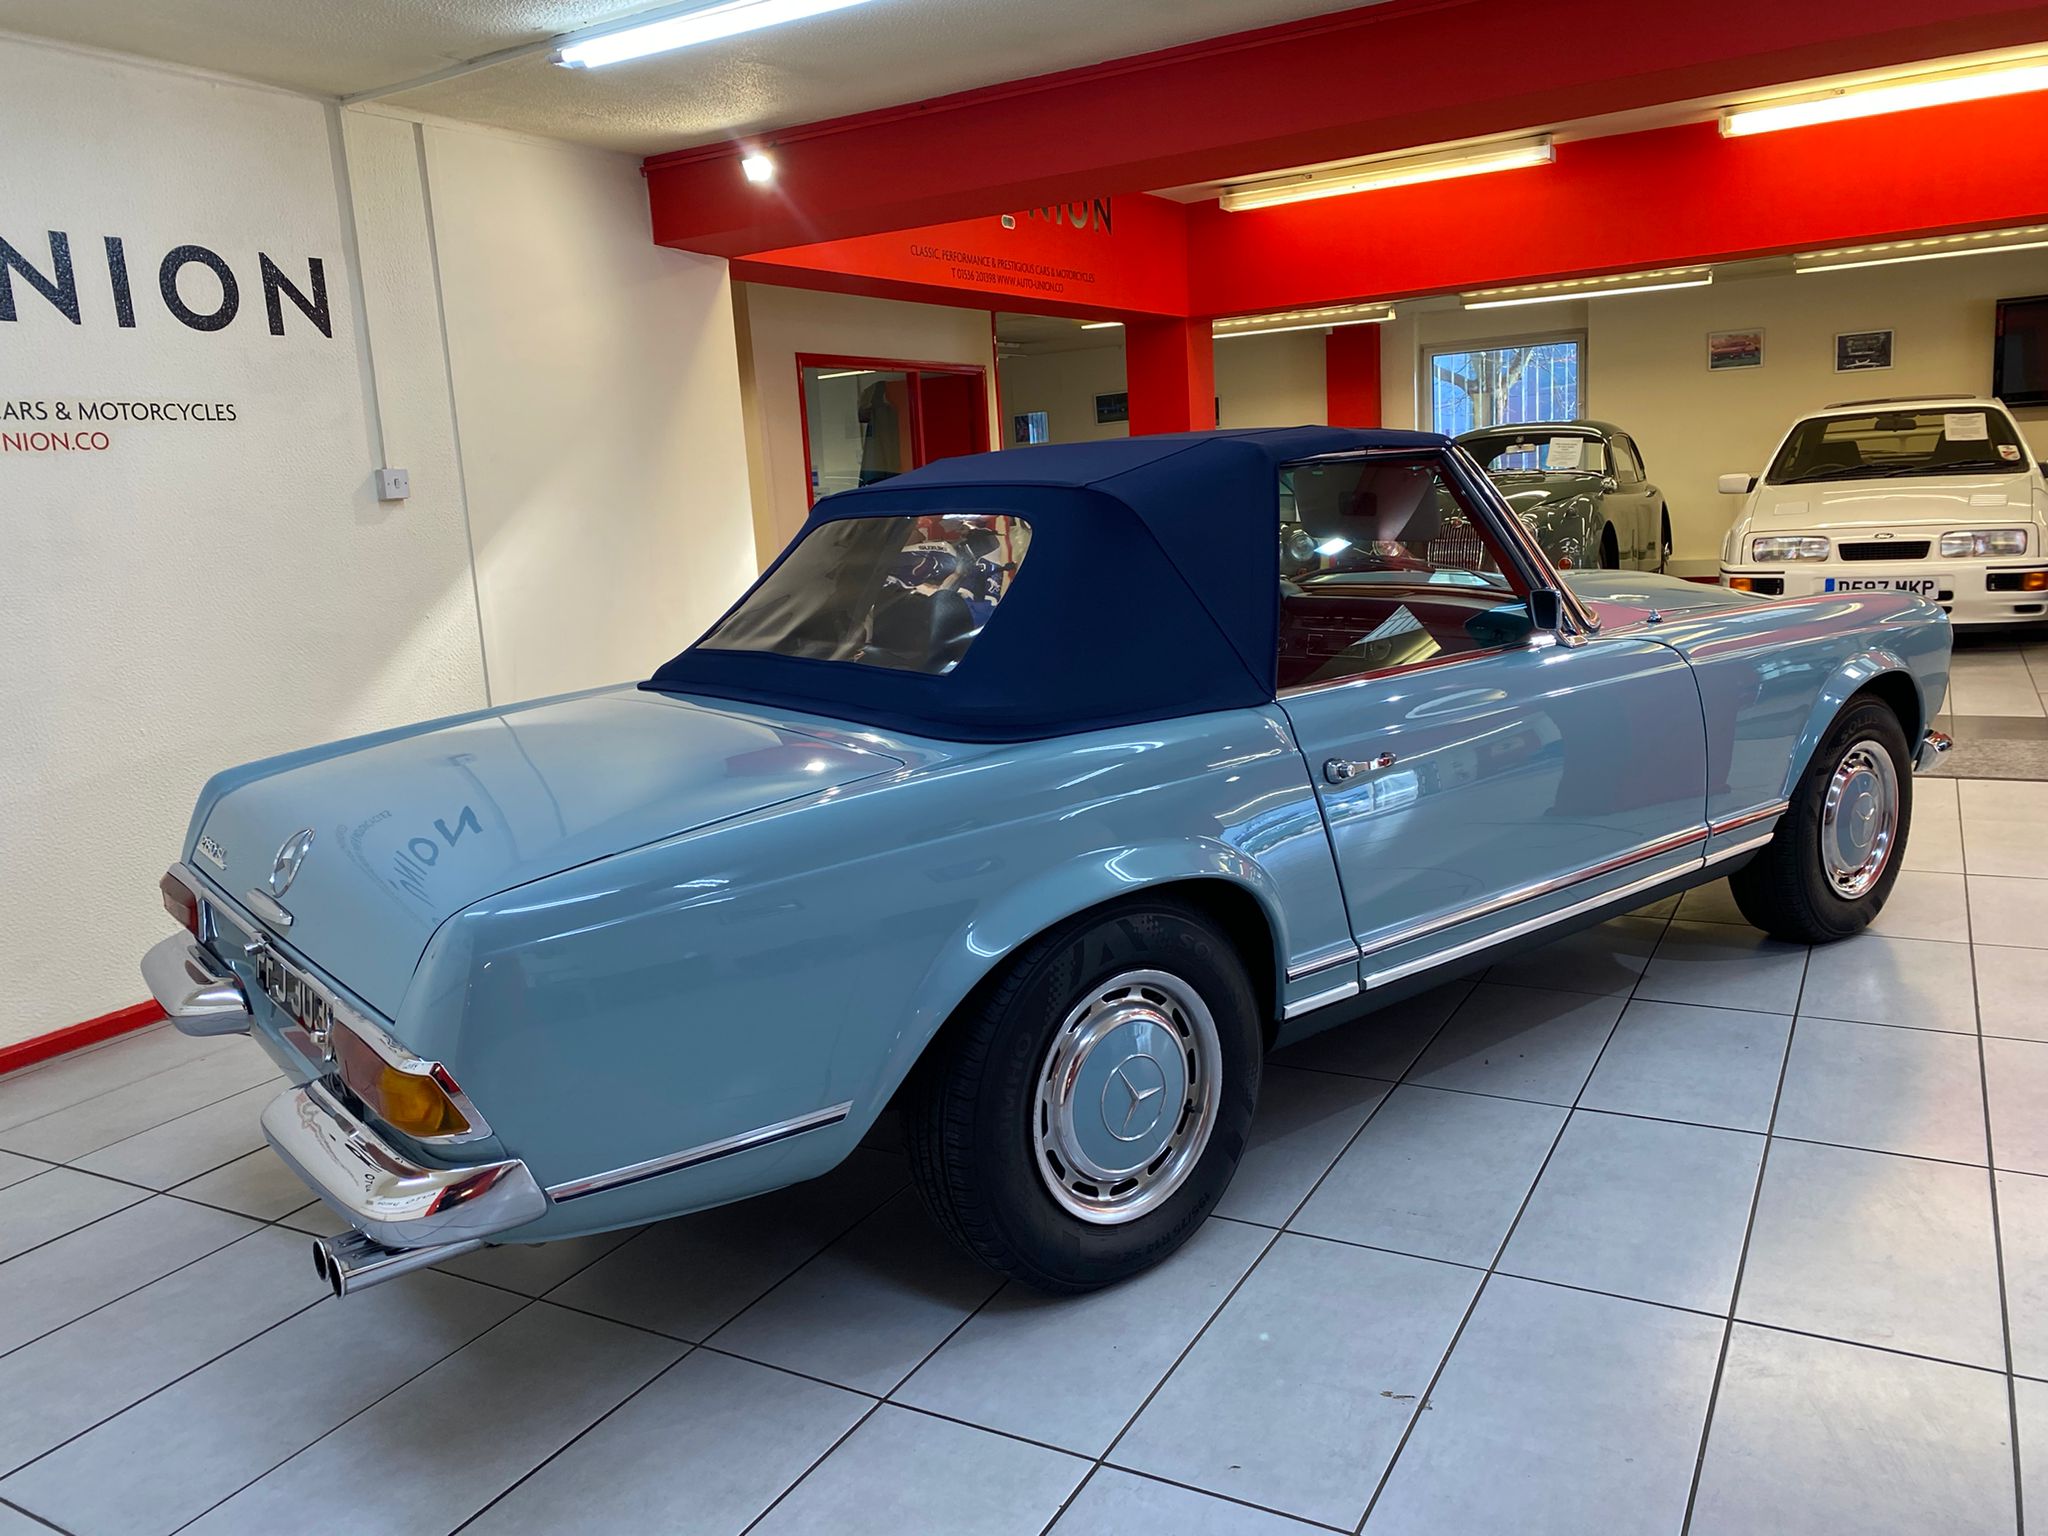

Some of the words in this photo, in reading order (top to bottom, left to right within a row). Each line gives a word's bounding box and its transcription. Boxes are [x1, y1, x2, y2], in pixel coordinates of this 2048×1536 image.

[942, 249, 991, 268] PERFORMANCE
[997, 259, 1035, 275] PRESTIGIOUS
[1035, 265, 1050, 277] CARS
[1055, 269, 1095, 284] MOTORCYCLES
[0, 401, 48, 421] ARS
[55, 402, 72, 420] &
[79, 402, 237, 421] MOTORCYCLES
[2, 431, 109, 452] NION.CO
